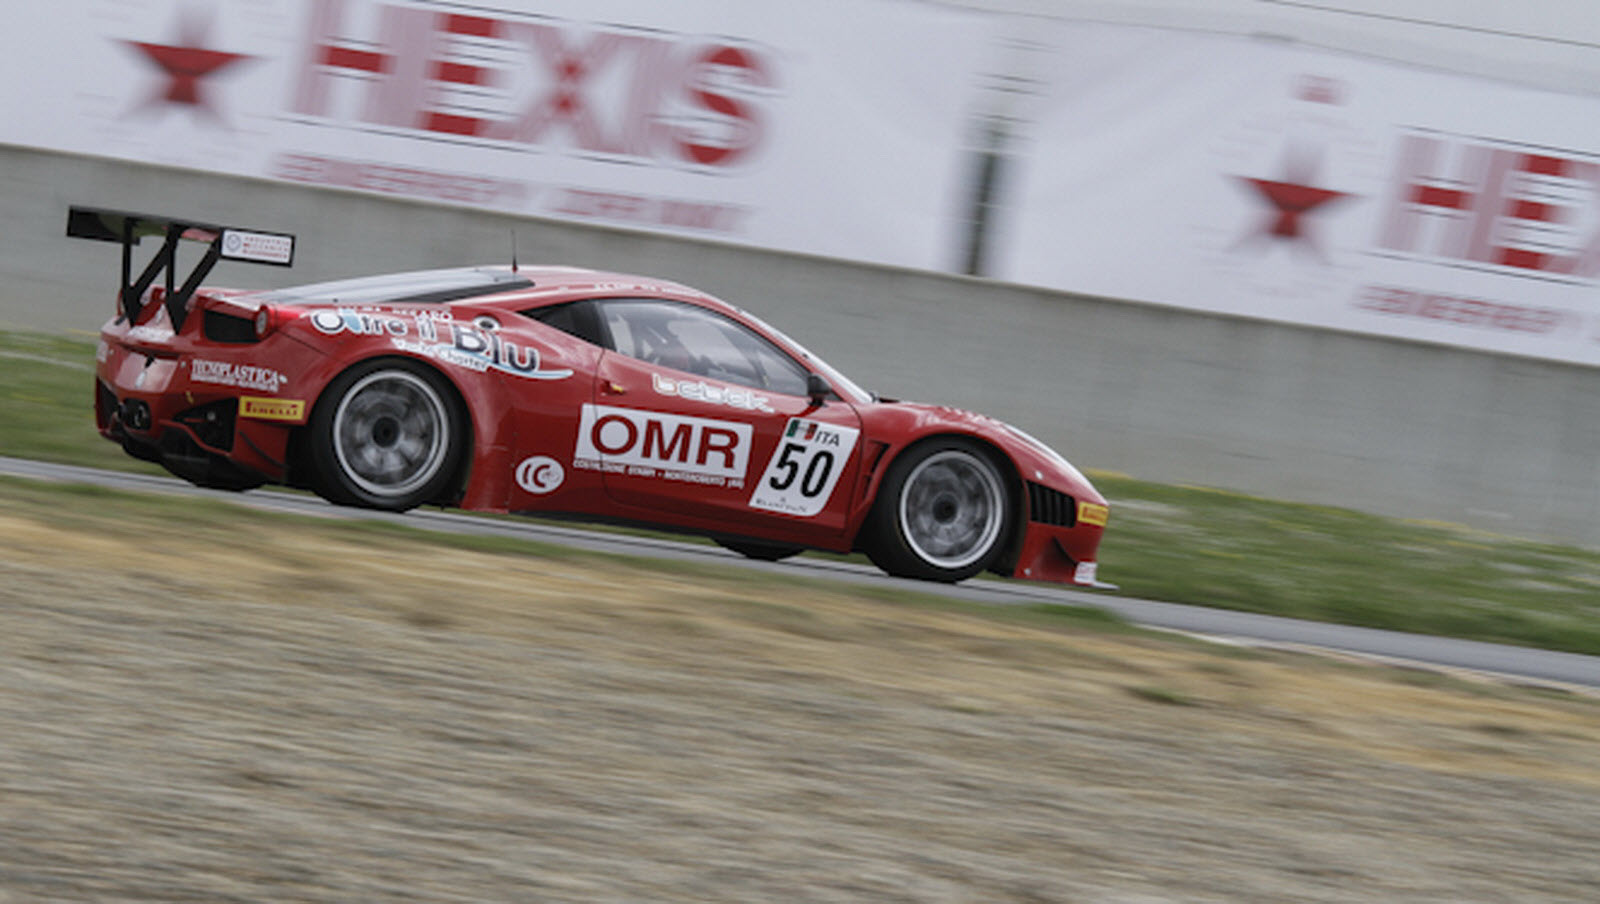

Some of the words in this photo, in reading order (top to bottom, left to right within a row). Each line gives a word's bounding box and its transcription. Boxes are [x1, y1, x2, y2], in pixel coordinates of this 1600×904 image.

[288, 0, 775, 172] HEXIS
[1374, 128, 1600, 280] HE
[591, 414, 740, 470] OMR
[815, 430, 840, 447] ITA
[769, 442, 835, 498] 50
